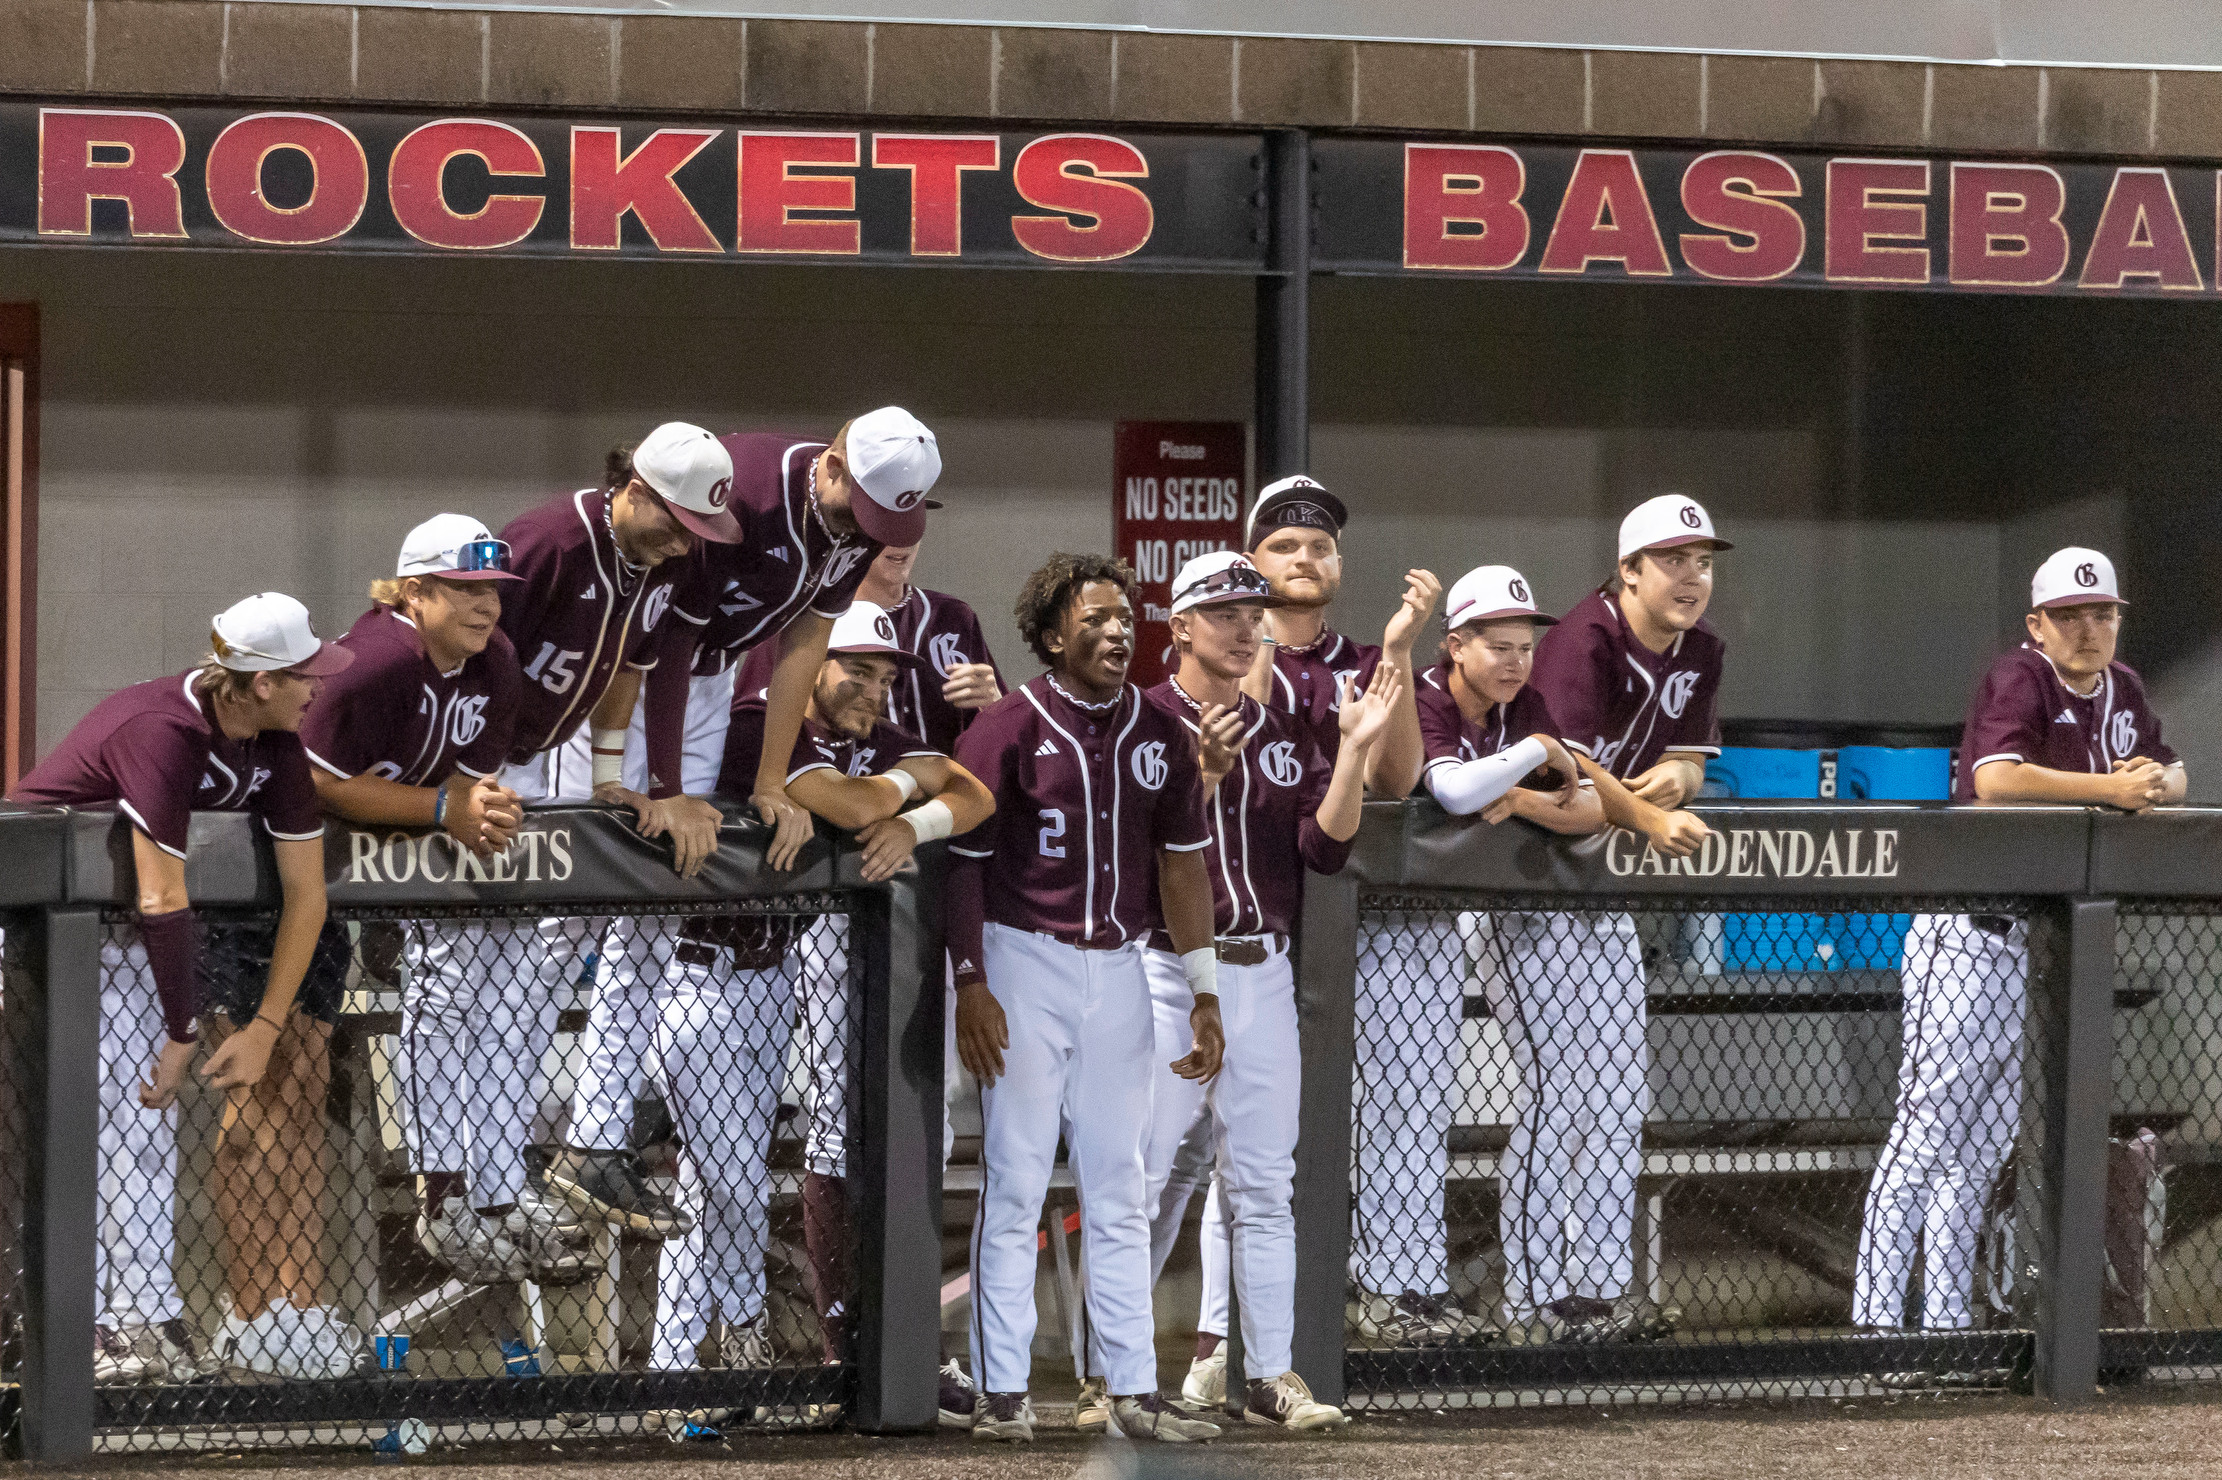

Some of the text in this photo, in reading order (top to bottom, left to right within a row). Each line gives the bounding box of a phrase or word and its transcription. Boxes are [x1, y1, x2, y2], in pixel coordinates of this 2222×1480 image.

[38, 107, 2222, 292] ROCKETS BASEBA
[1159, 440, 1206, 460] Please
[1125, 476, 1158, 520] NO
[1164, 476, 1239, 521] SEEDS
[1135, 539, 1168, 584] NO
[2073, 562, 2099, 588] G
[523, 641, 585, 695] 15
[1130, 740, 1169, 791] G
[1258, 740, 1303, 788] G
[1037, 808, 1067, 859] 2
